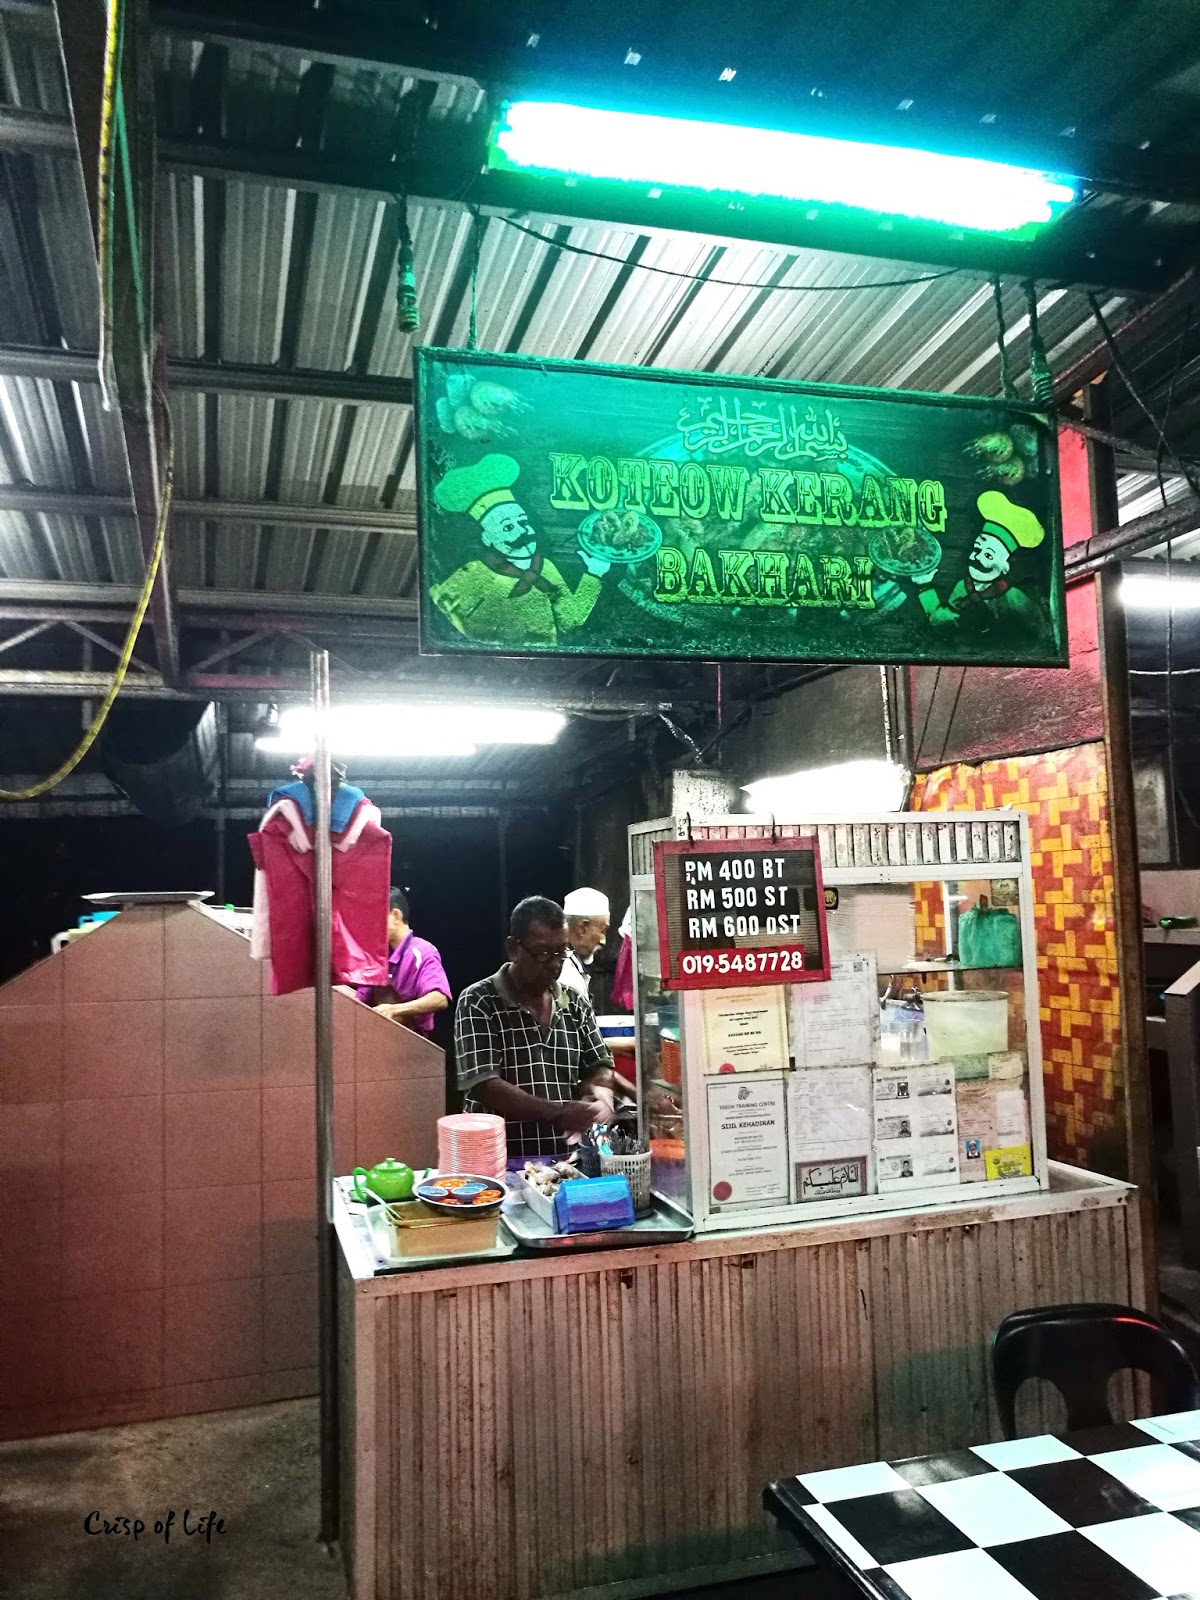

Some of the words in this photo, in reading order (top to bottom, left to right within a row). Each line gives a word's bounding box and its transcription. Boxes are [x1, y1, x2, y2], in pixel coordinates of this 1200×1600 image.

[550, 452, 750, 521] KOTEOW
[759, 467, 948, 533] KERANG
[654, 547, 876, 609] BAKHARI
[719, 858, 755, 881] 400
[763, 858, 785, 879] BT
[687, 889, 716, 910] RM
[721, 886, 757, 909] 500
[765, 886, 788, 907] ST
[689, 917, 718, 939] RM
[724, 915, 760, 937] 600
[739, 1120, 775, 1128] KEHADIRAN
